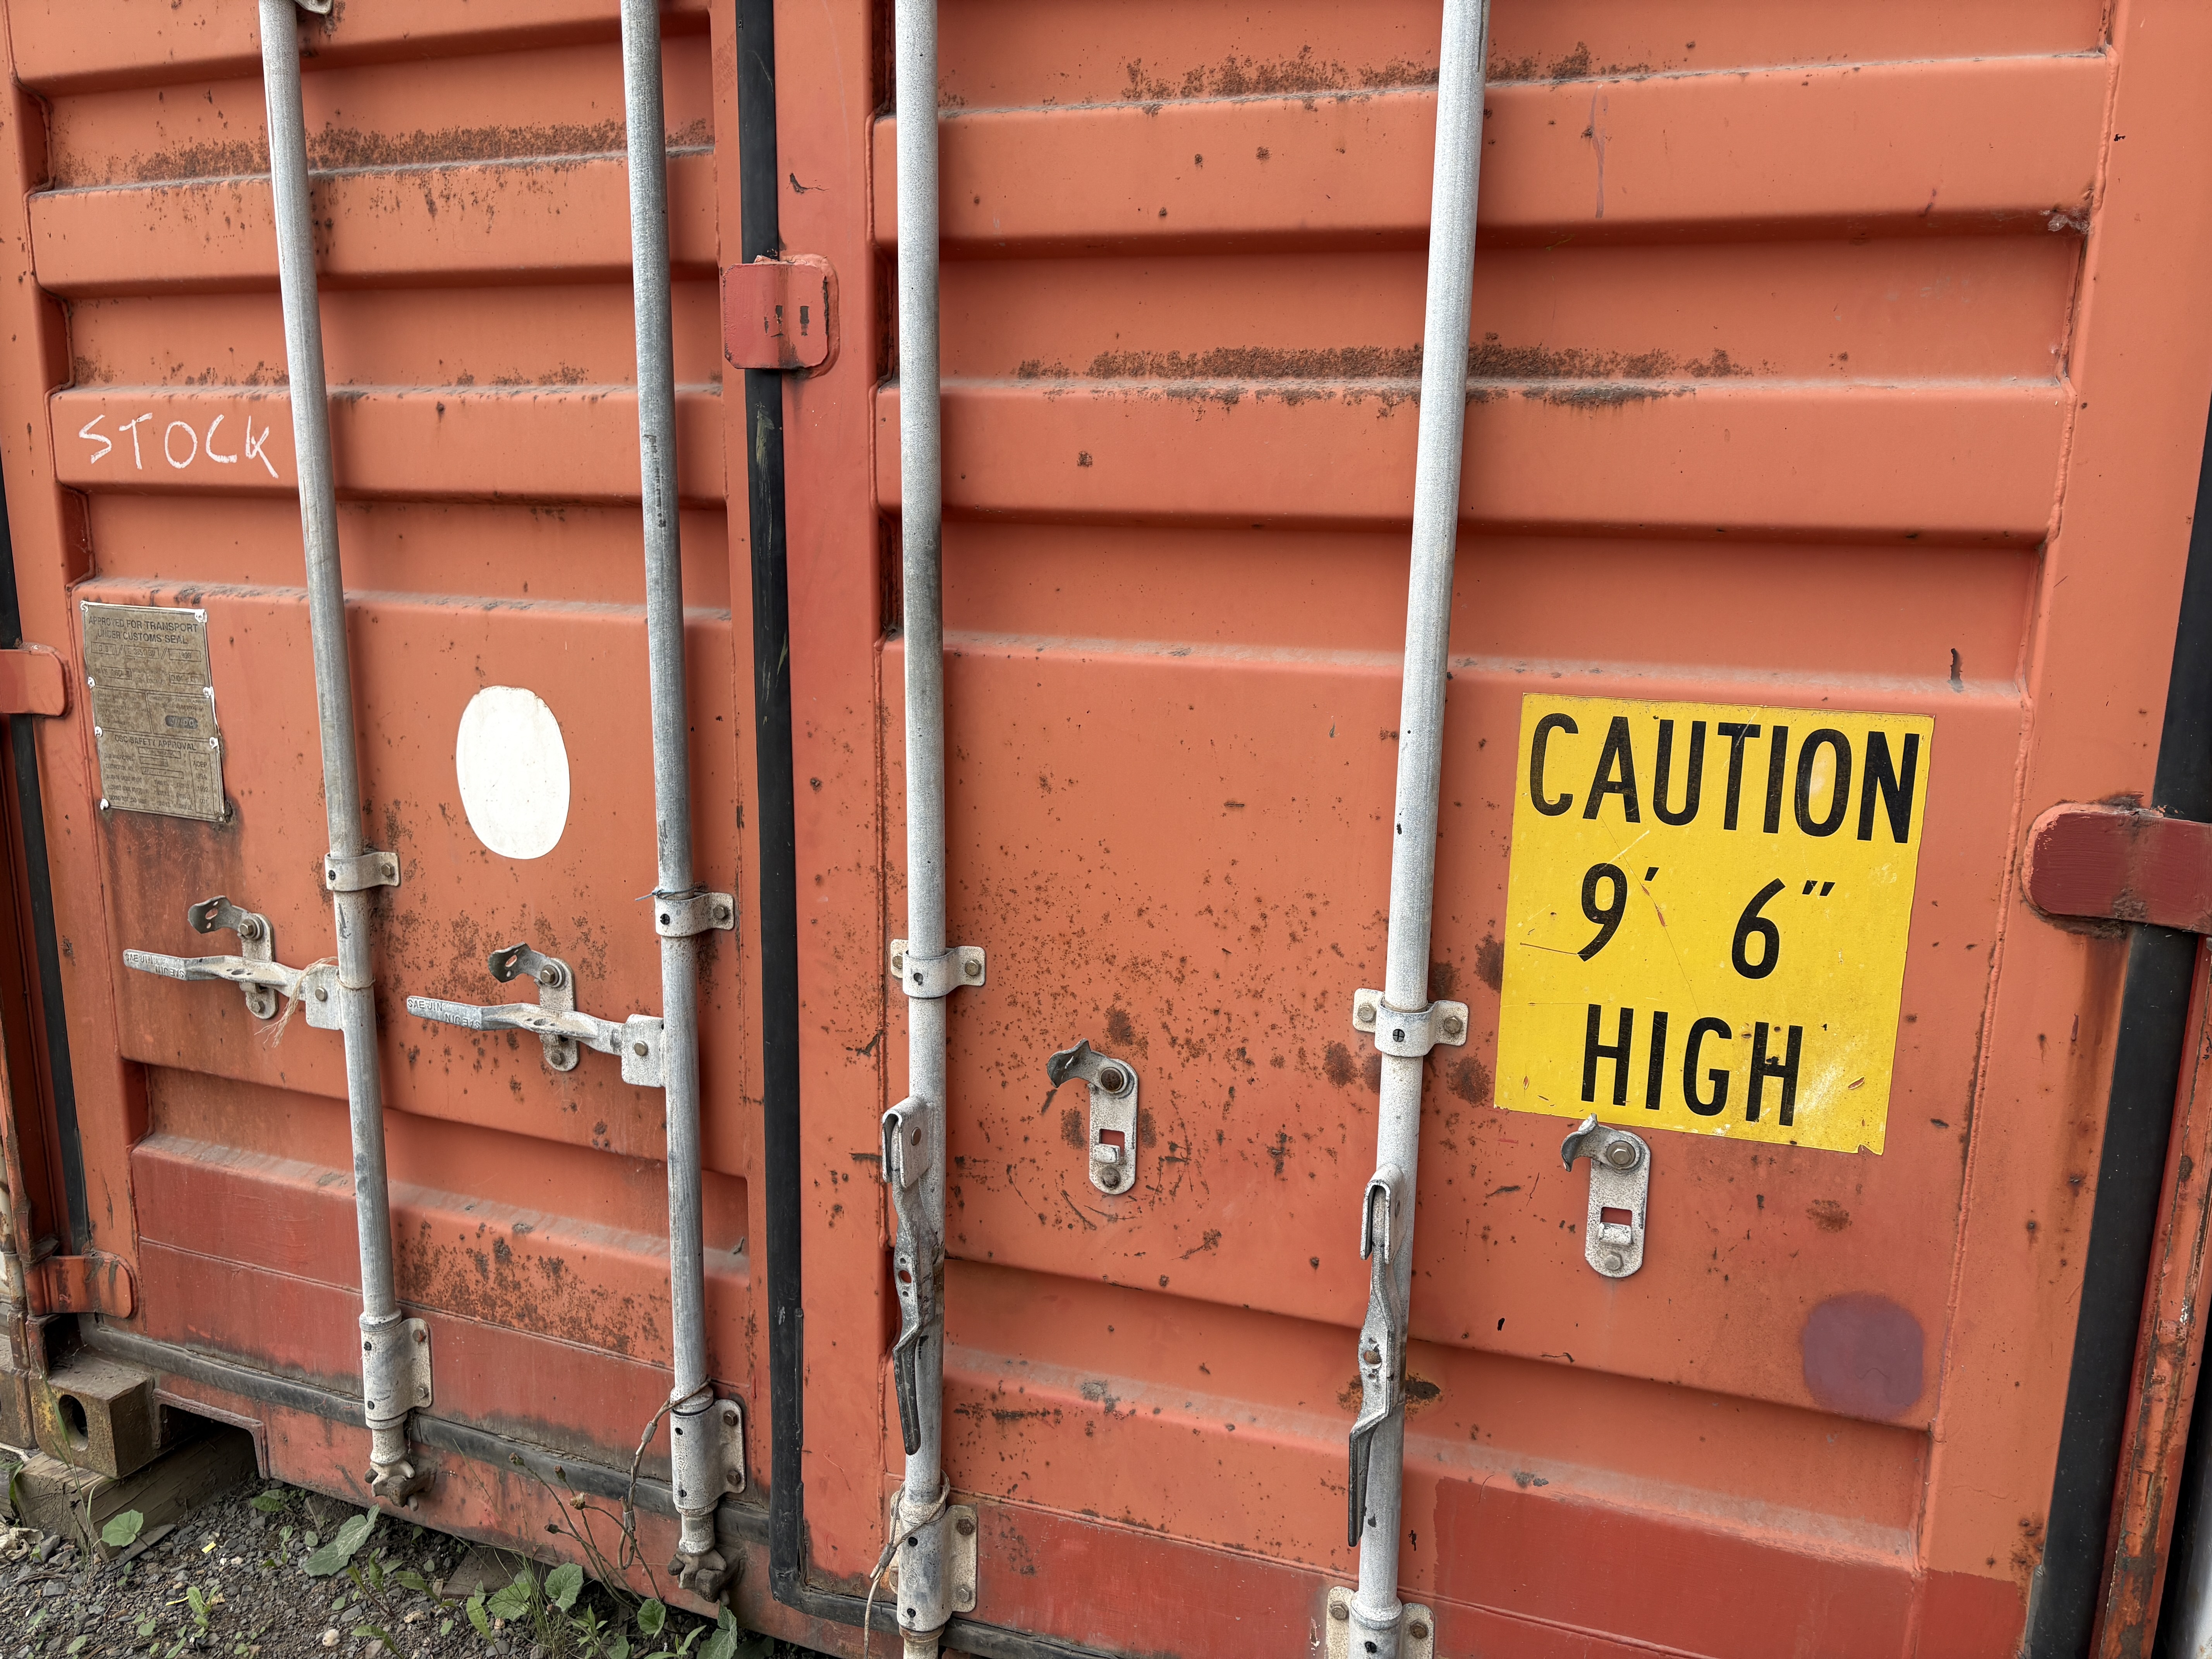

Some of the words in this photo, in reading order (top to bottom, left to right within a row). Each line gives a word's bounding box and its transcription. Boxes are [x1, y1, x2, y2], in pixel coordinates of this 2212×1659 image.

[79, 412, 278, 478] STOCK
[89, 616, 124, 628] APPROVED
[126, 620, 142, 629] FOR
[144, 621, 198, 632] TRANSPORT
[97, 629, 120, 639] UNDER
[123, 632, 162, 643] CUSTOMS
[165, 634, 189, 644] SEAL
[130, 736, 155, 746] SAFETY
[158, 739, 197, 751] APPROVAL
[1530, 713, 1920, 844] CAUTION
[407, 999, 425, 1009] SAE
[427, 1001, 443, 1012] JIN
[445, 1013, 460, 1024] JIN
[1581, 1004, 1803, 1127] HIGH
